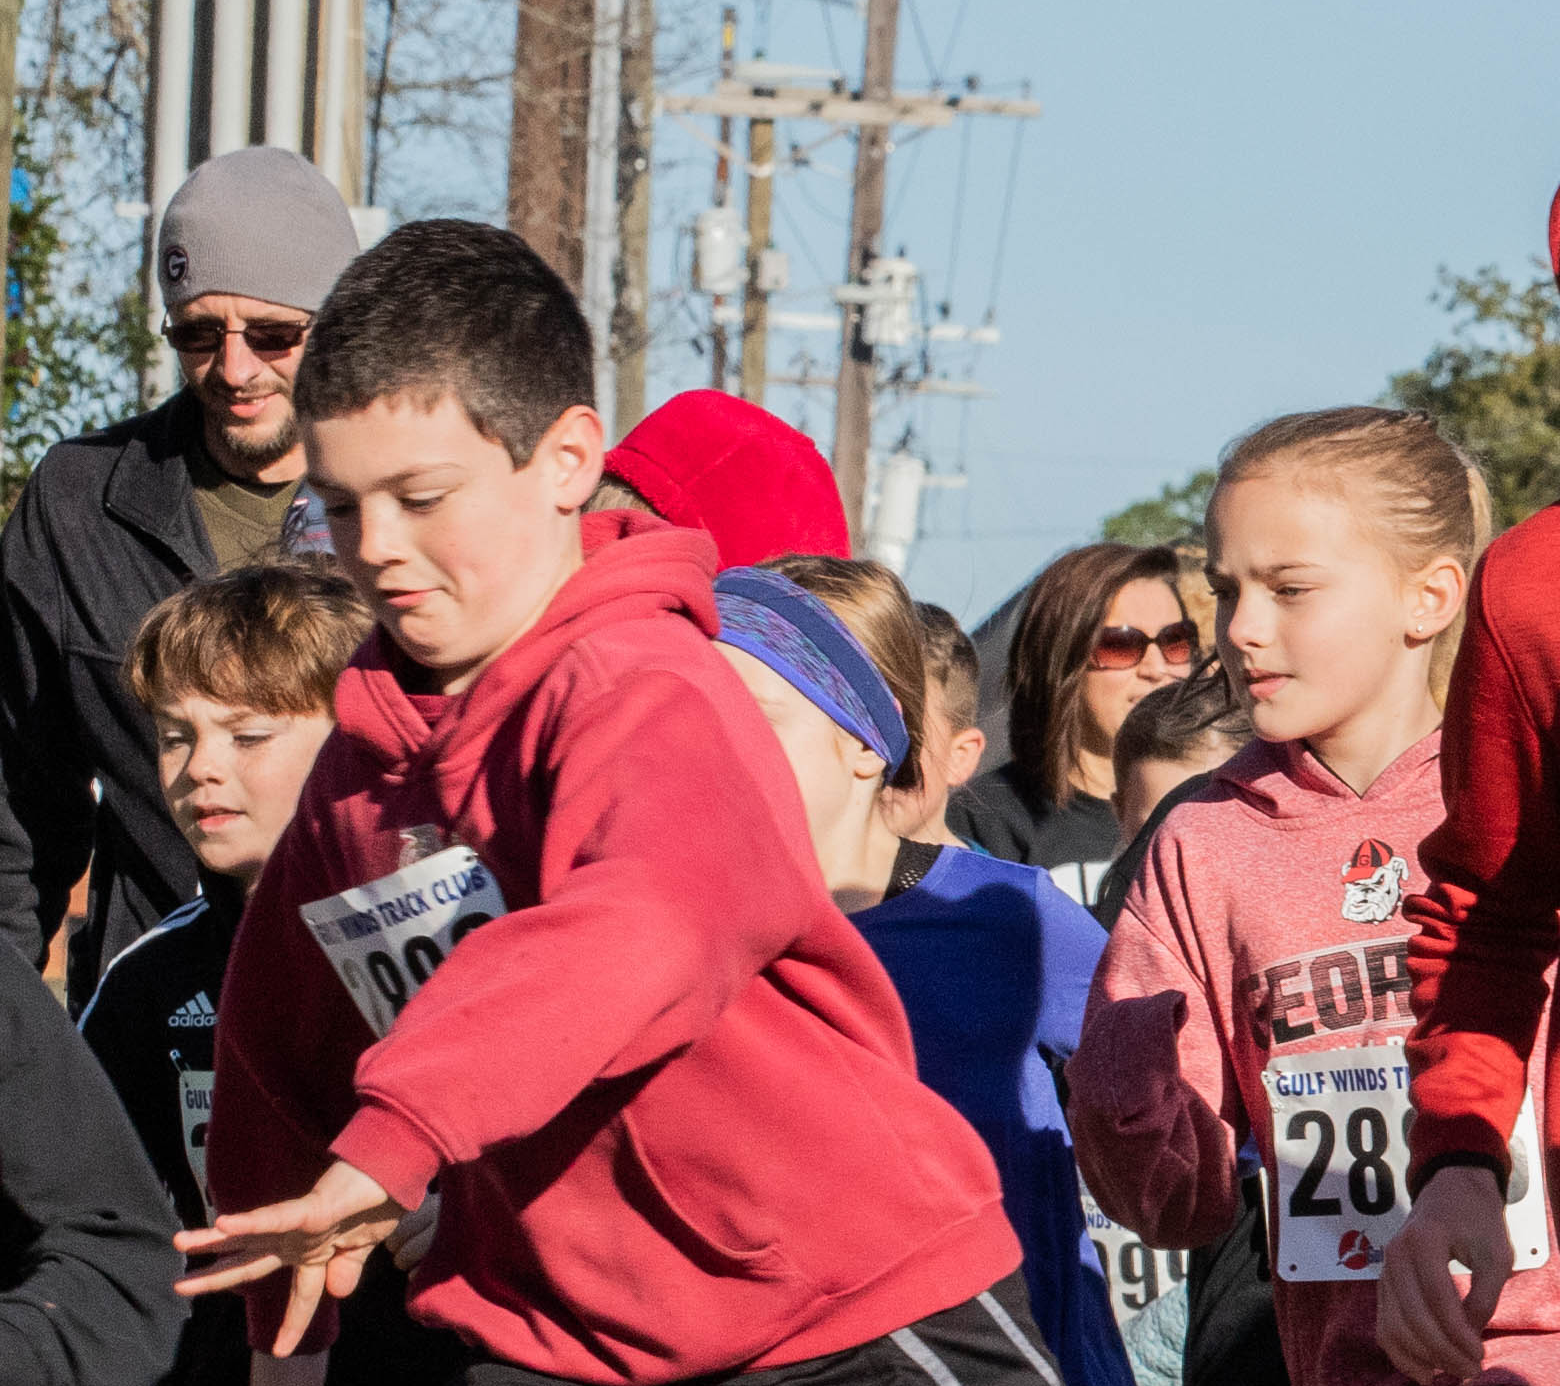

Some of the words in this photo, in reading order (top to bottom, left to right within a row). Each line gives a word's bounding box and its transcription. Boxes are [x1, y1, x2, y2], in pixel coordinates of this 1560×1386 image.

[1277, 1072, 1325, 1096] GULF
[1330, 1067, 1387, 1092] WINDS
[185, 1090, 213, 1109] GUL
[1087, 1213, 1112, 1229] NDS
